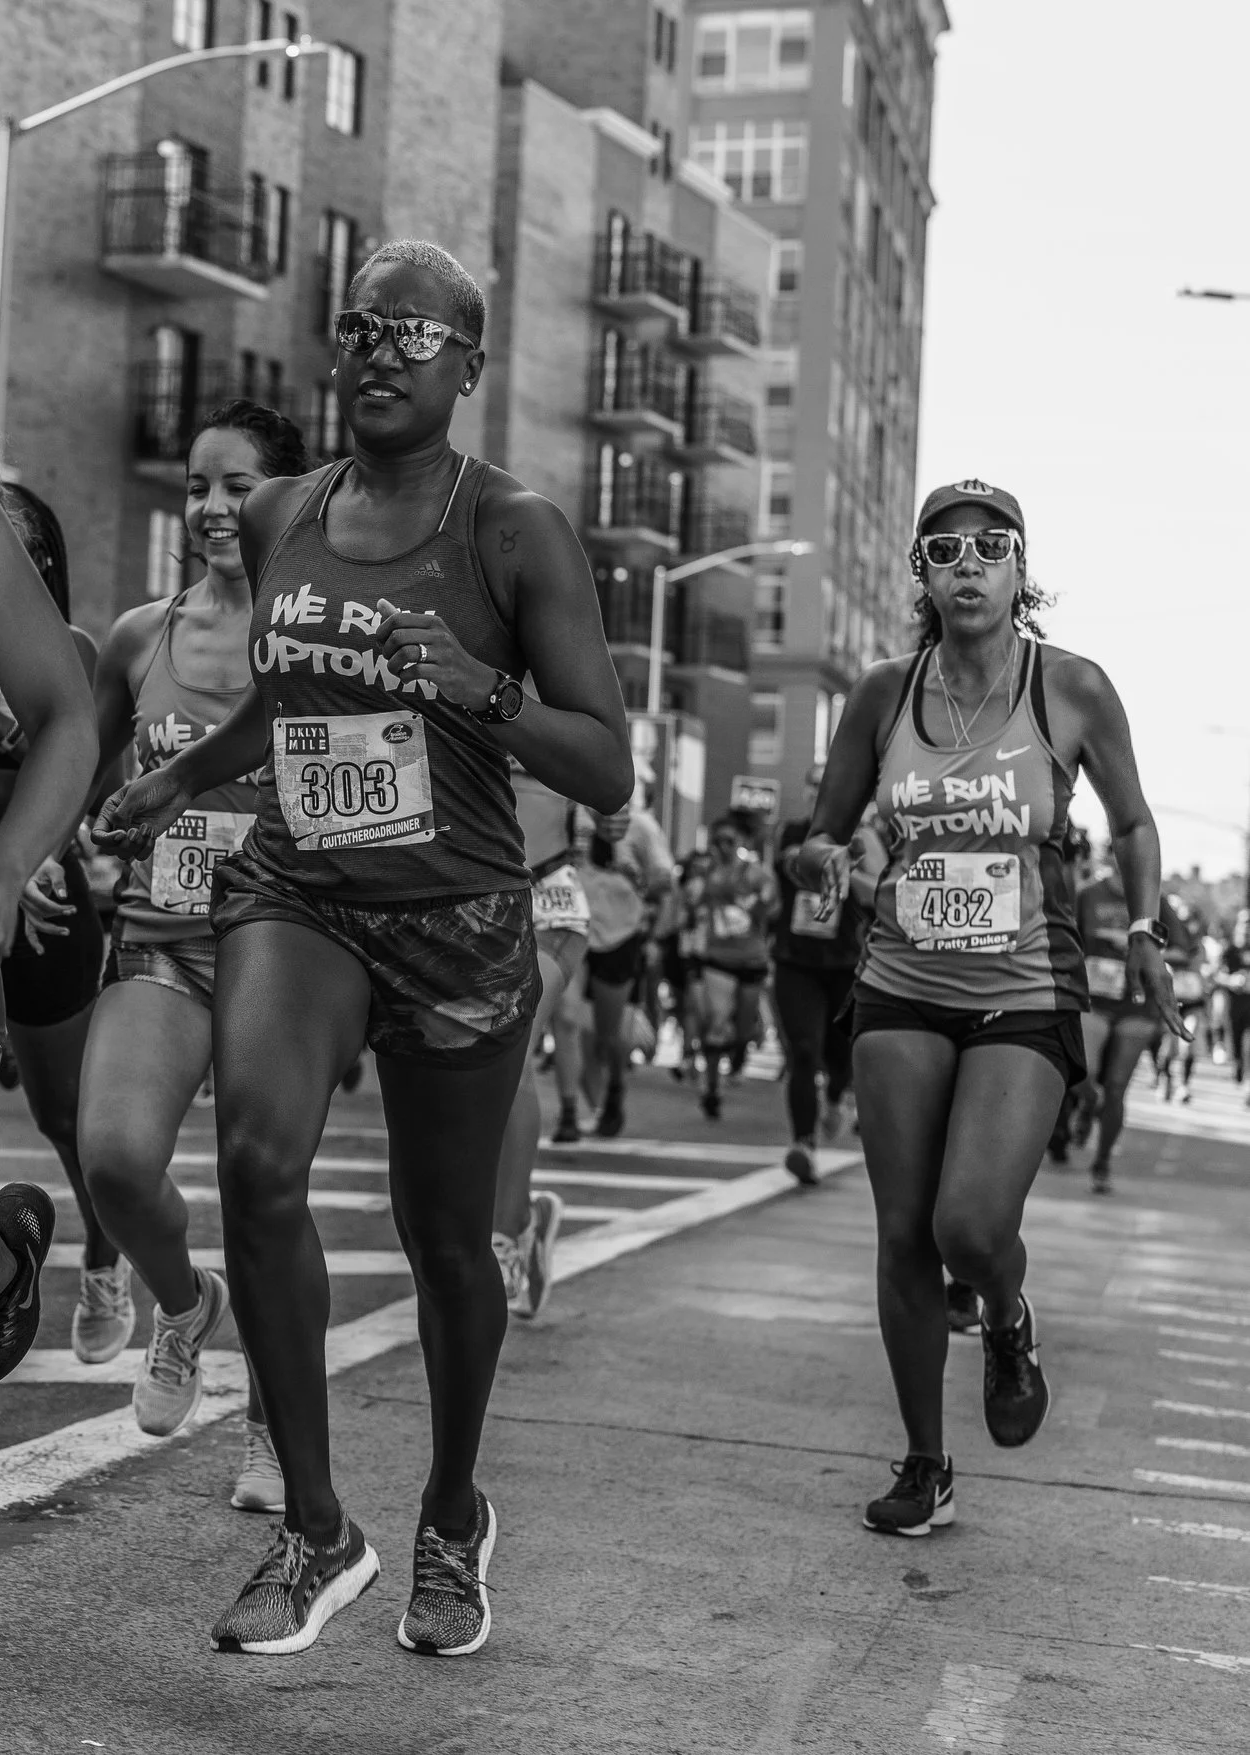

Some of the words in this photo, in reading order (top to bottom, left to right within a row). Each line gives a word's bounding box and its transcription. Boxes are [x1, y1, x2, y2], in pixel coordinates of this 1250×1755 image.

[414, 569, 445, 578] adidas
[271, 583, 327, 626] WE
[148, 713, 195, 752] WE
[289, 727, 326, 738] BKLYN
[288, 739, 327, 751] MILE
[301, 760, 399, 818] 303
[892, 770, 933, 808] WE
[942, 769, 1016, 804] RUN
[172, 818, 204, 828] KLYN
[169, 826, 204, 838] MILE
[322, 818, 421, 849] QUITATHEROADRUNNER
[908, 869, 943, 880] MILE
[921, 887, 993, 928] 482
[937, 938, 968, 951] Patty
[970, 934, 1009, 947] Dukes
